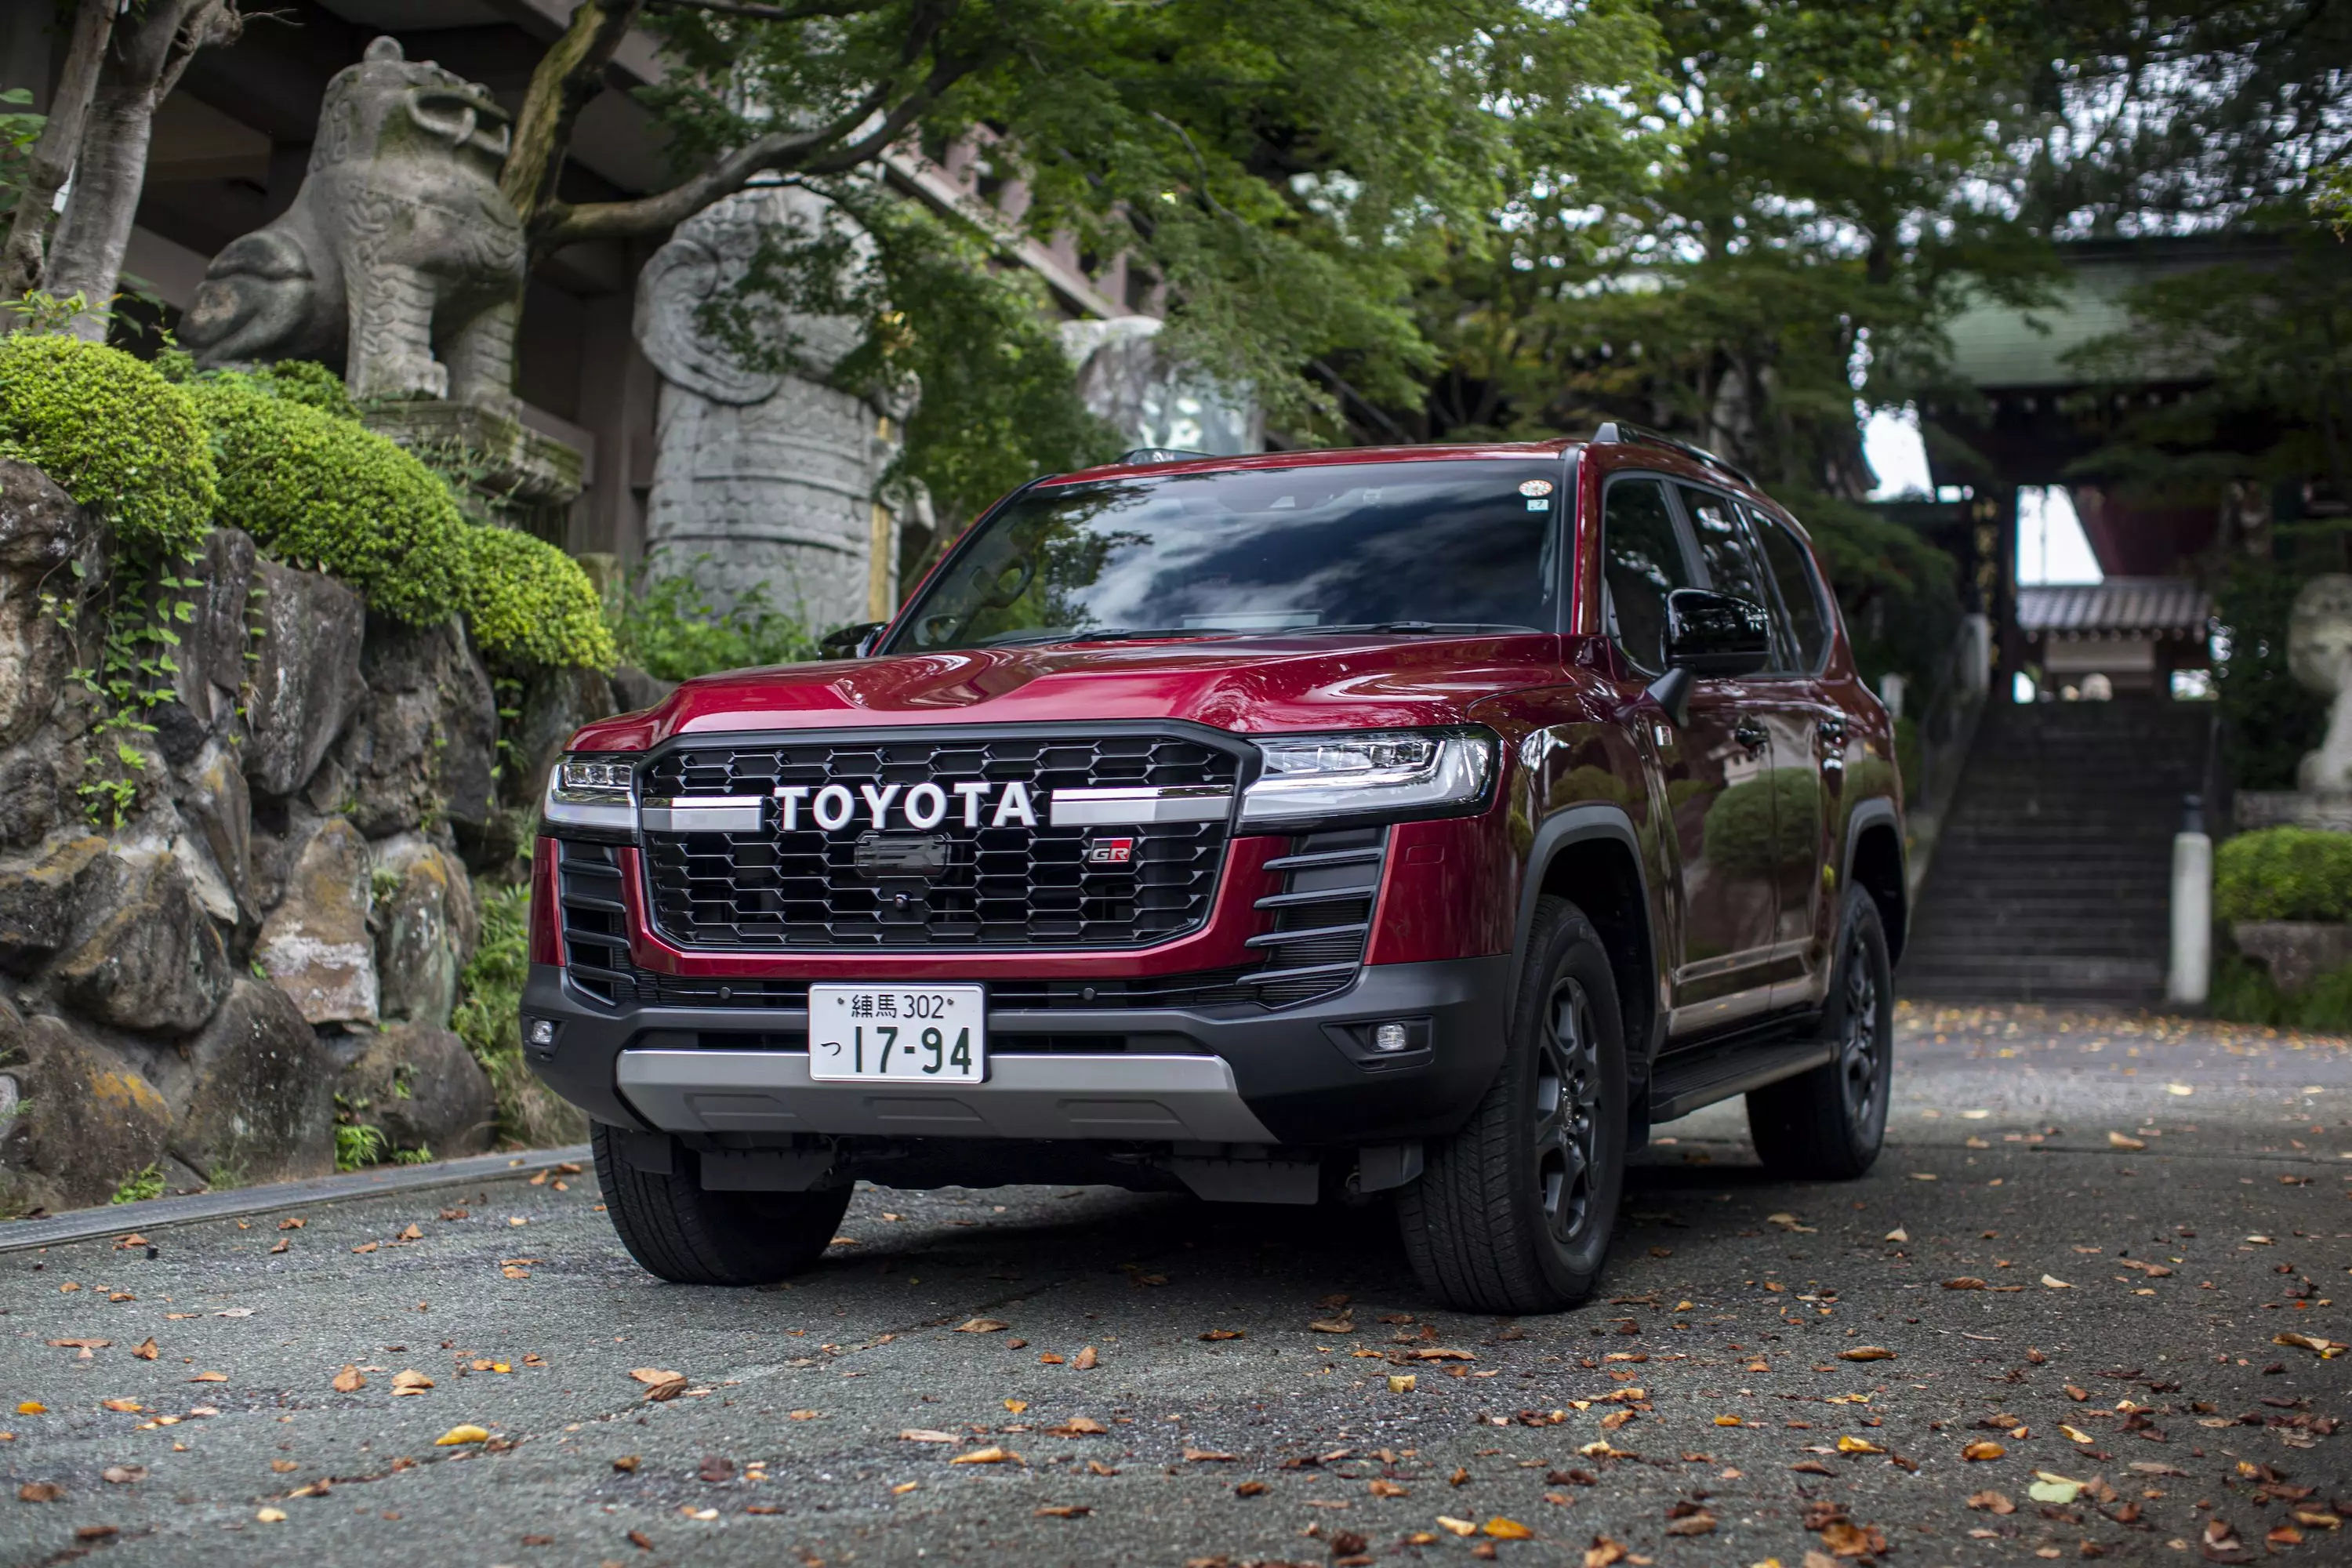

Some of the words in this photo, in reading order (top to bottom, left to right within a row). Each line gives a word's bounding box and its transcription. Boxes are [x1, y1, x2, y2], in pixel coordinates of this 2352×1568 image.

[774, 782, 1038, 831] TOYOTA
[1092, 848, 1129, 860] GR
[851, 994, 897, 1018] 練馬
[903, 995, 944, 1018] 302
[821, 1042, 841, 1056] つ
[855, 1026, 971, 1074] 17-94
